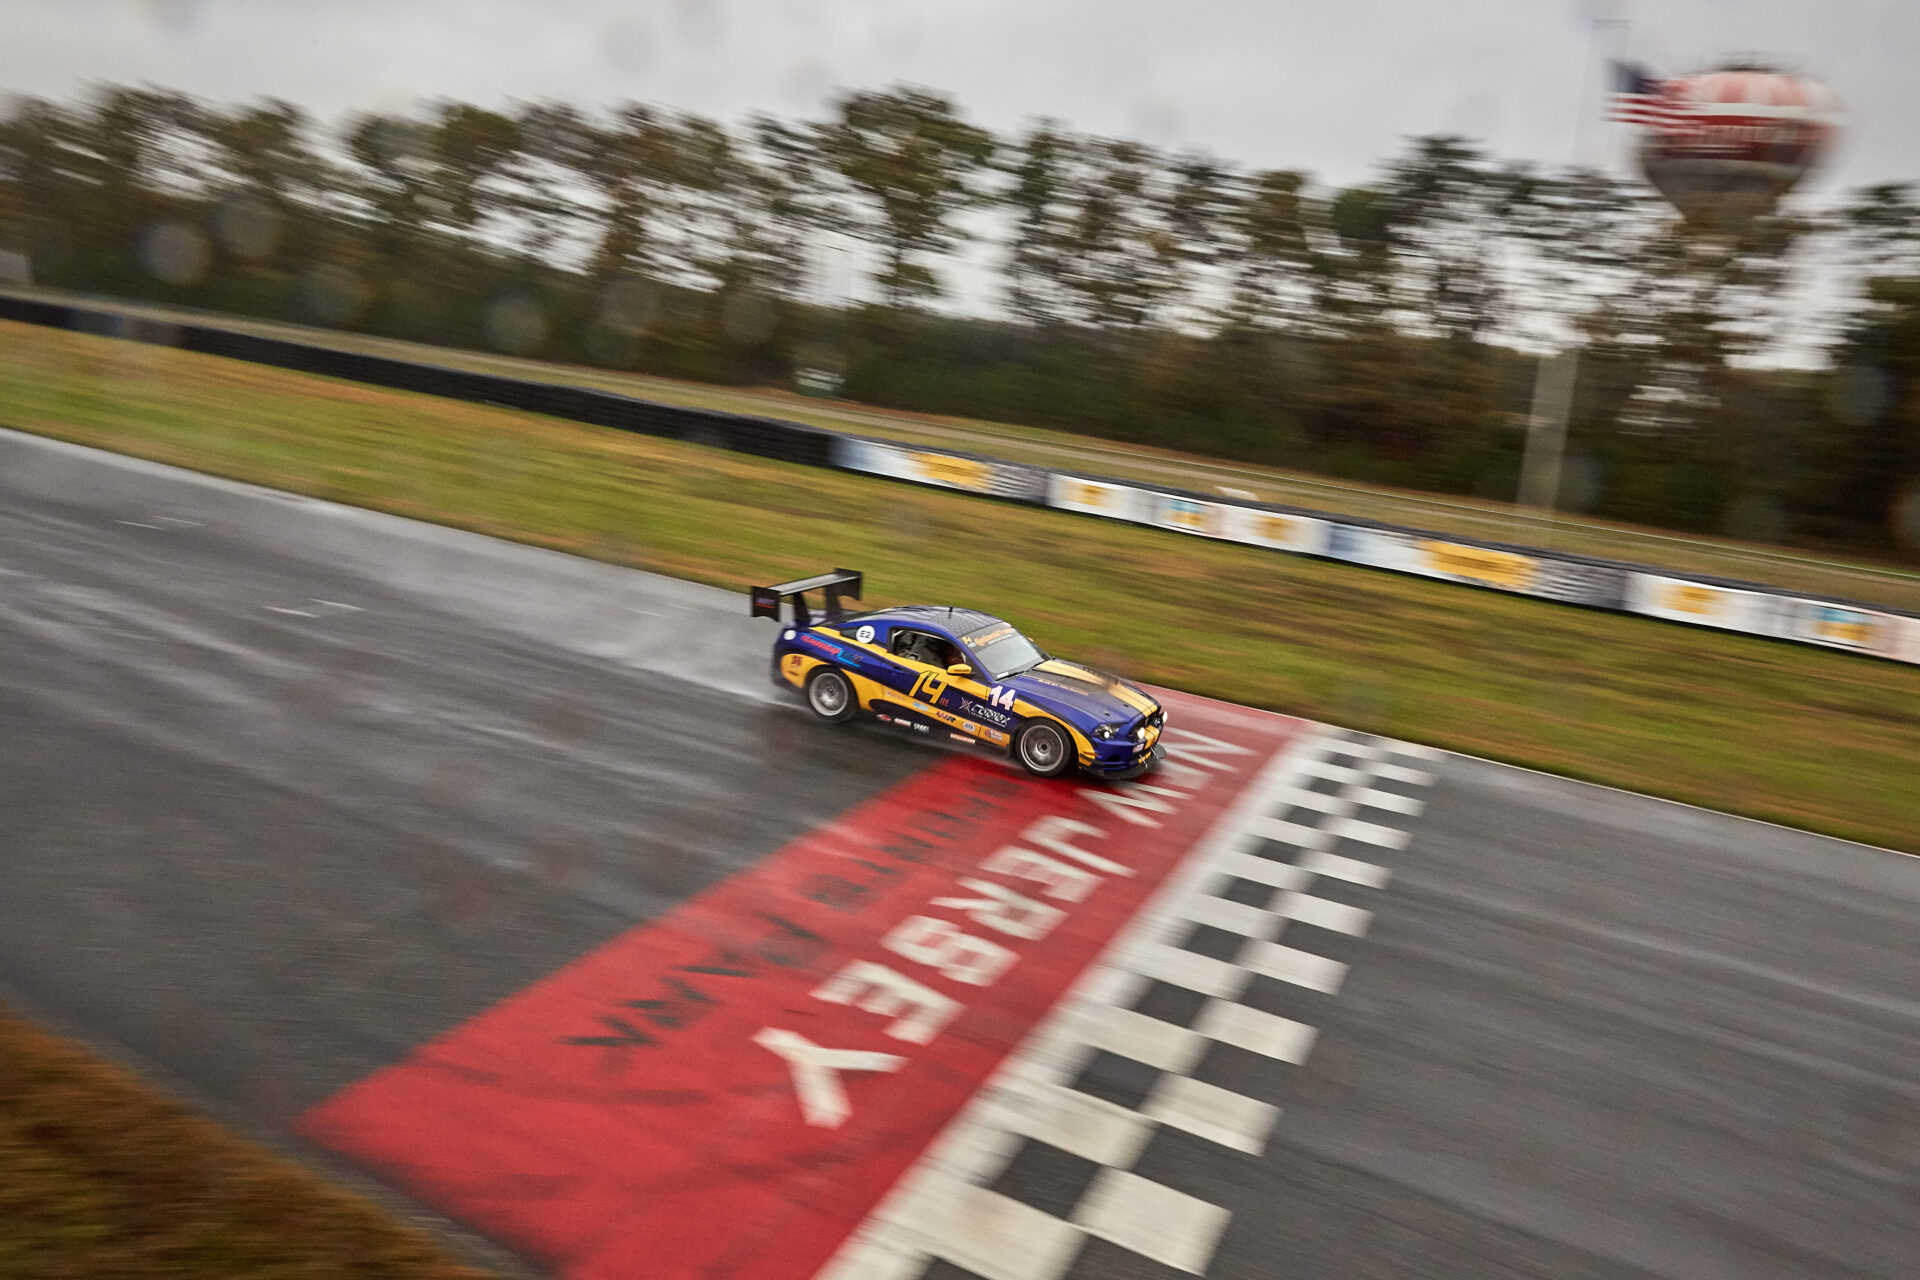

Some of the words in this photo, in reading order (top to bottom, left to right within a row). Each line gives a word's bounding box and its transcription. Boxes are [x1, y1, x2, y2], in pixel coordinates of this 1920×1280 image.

[860, 630, 872, 639] E2
[908, 670, 948, 704] 14
[990, 685, 1016, 711] 14
[1073, 725, 1258, 830] NEW
[750, 814, 1137, 1130] JERSEY
